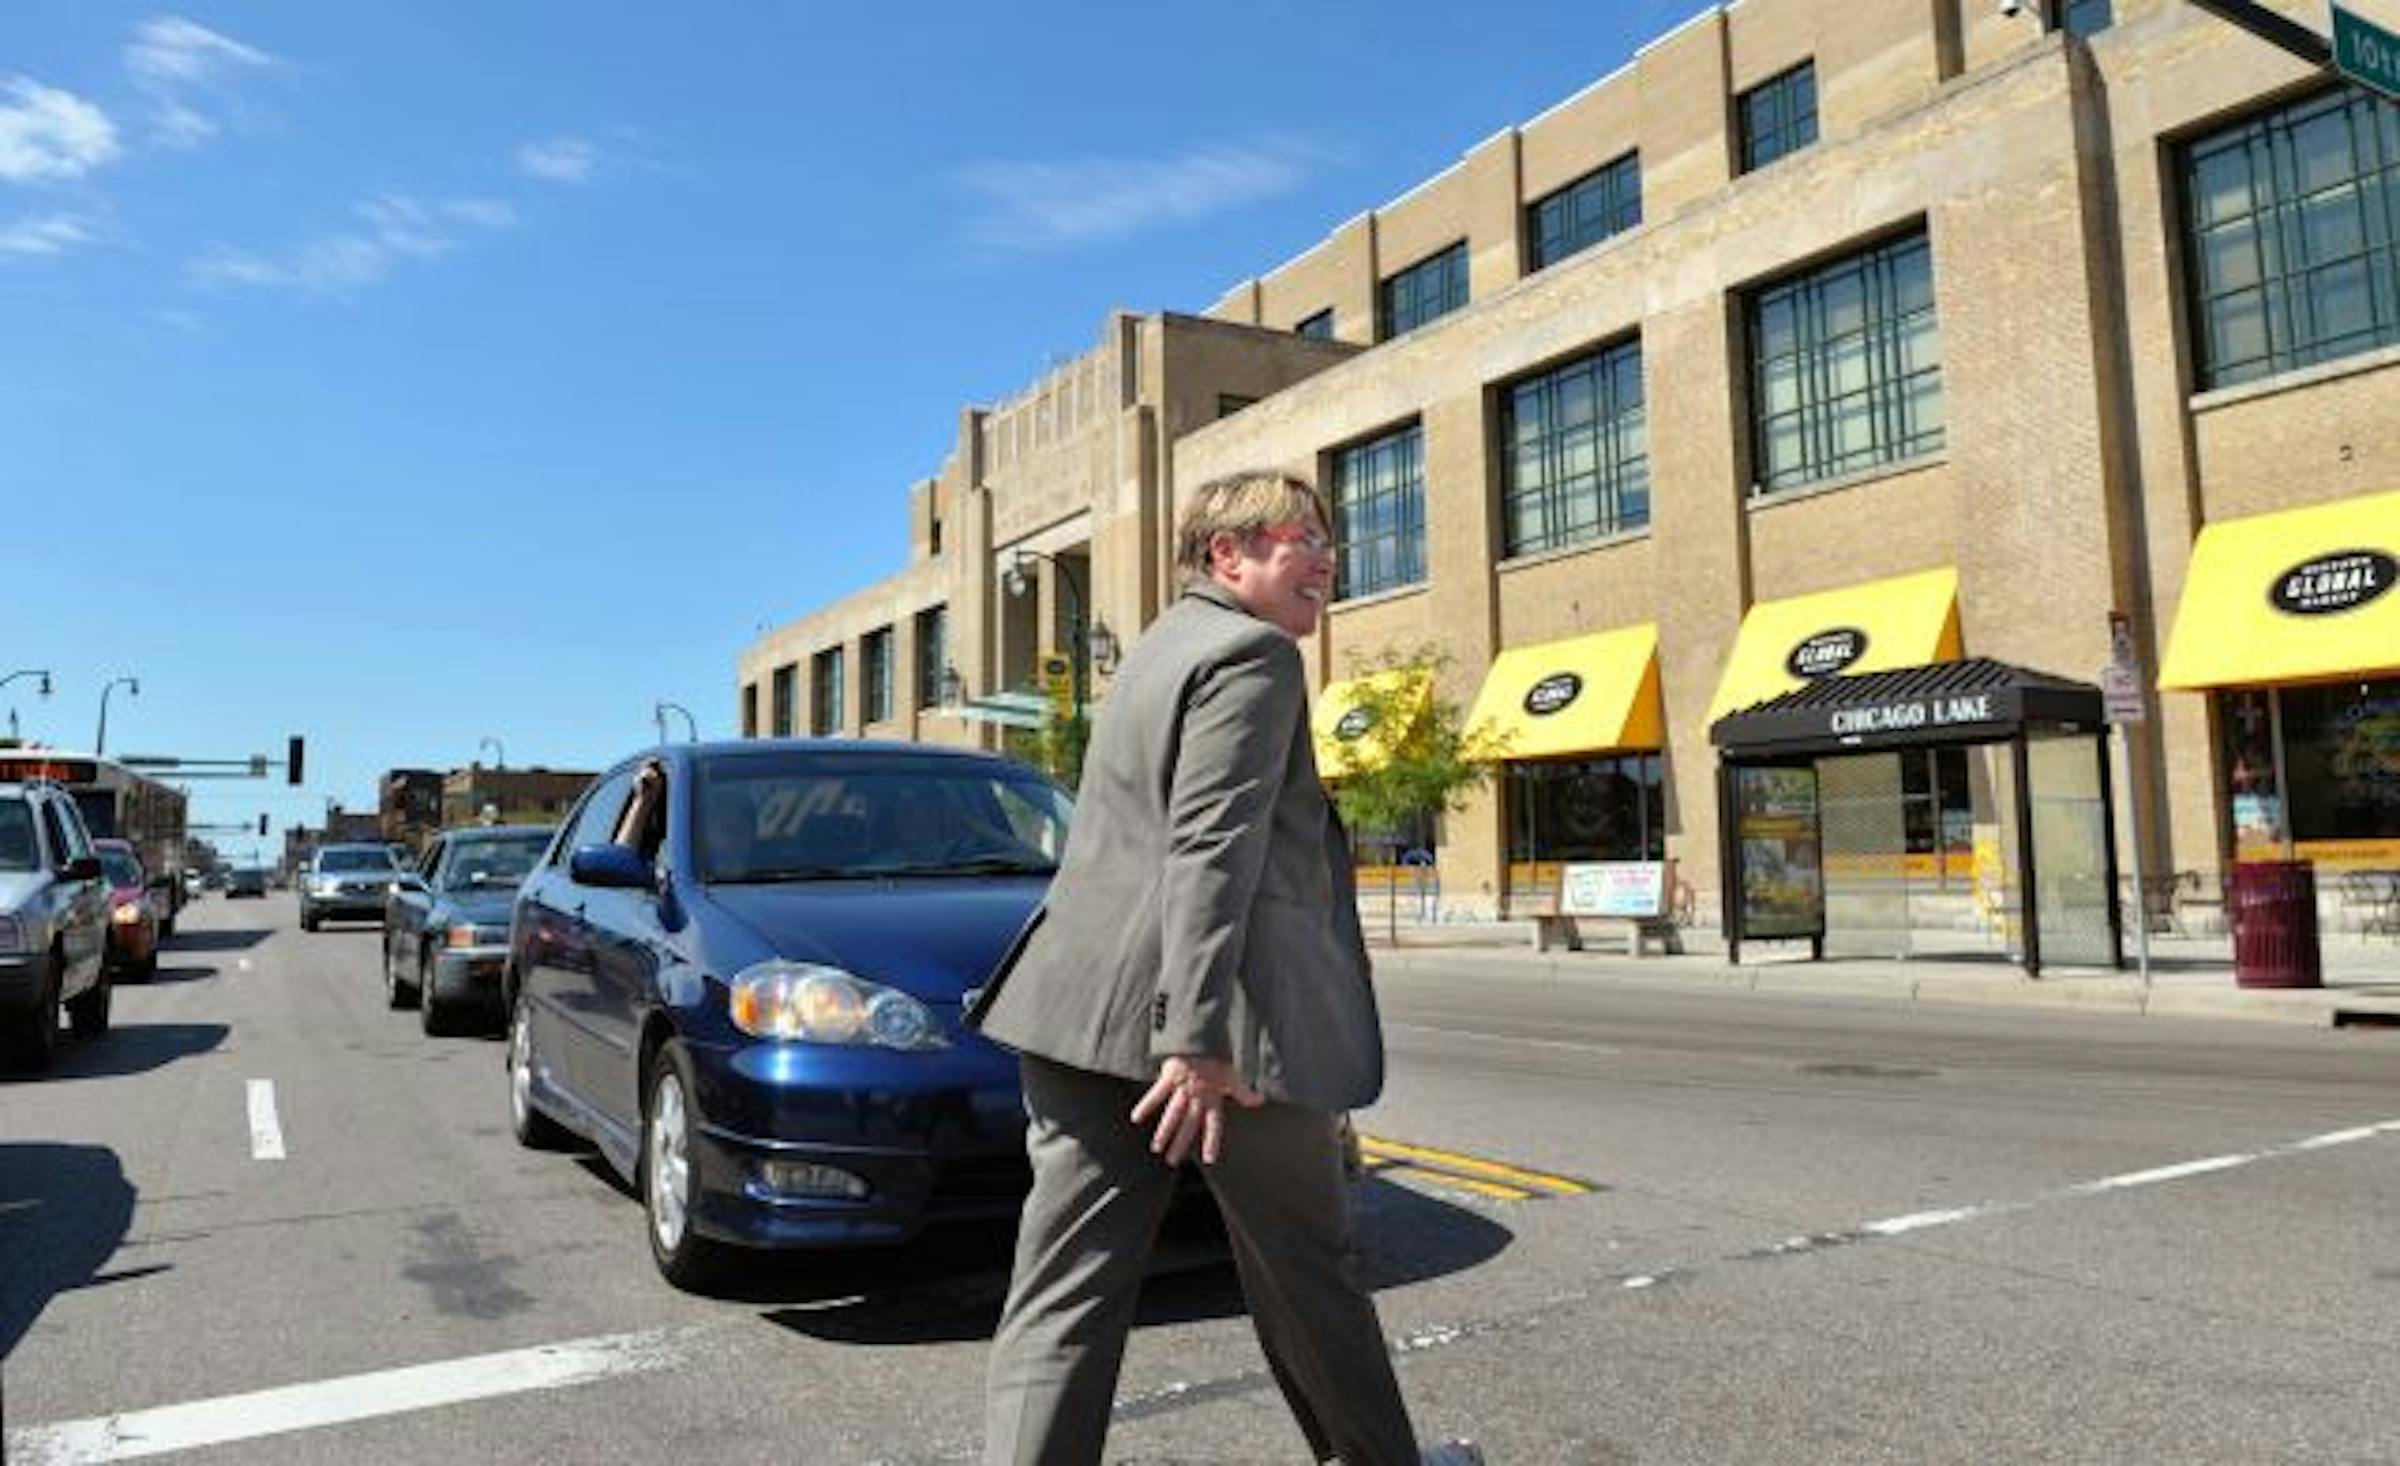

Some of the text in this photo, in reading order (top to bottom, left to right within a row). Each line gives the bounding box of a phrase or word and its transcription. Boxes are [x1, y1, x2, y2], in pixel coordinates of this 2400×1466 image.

[2286, 566, 2376, 598] GLOBAL
[1832, 696, 1992, 733] CHICAGO LAKE
